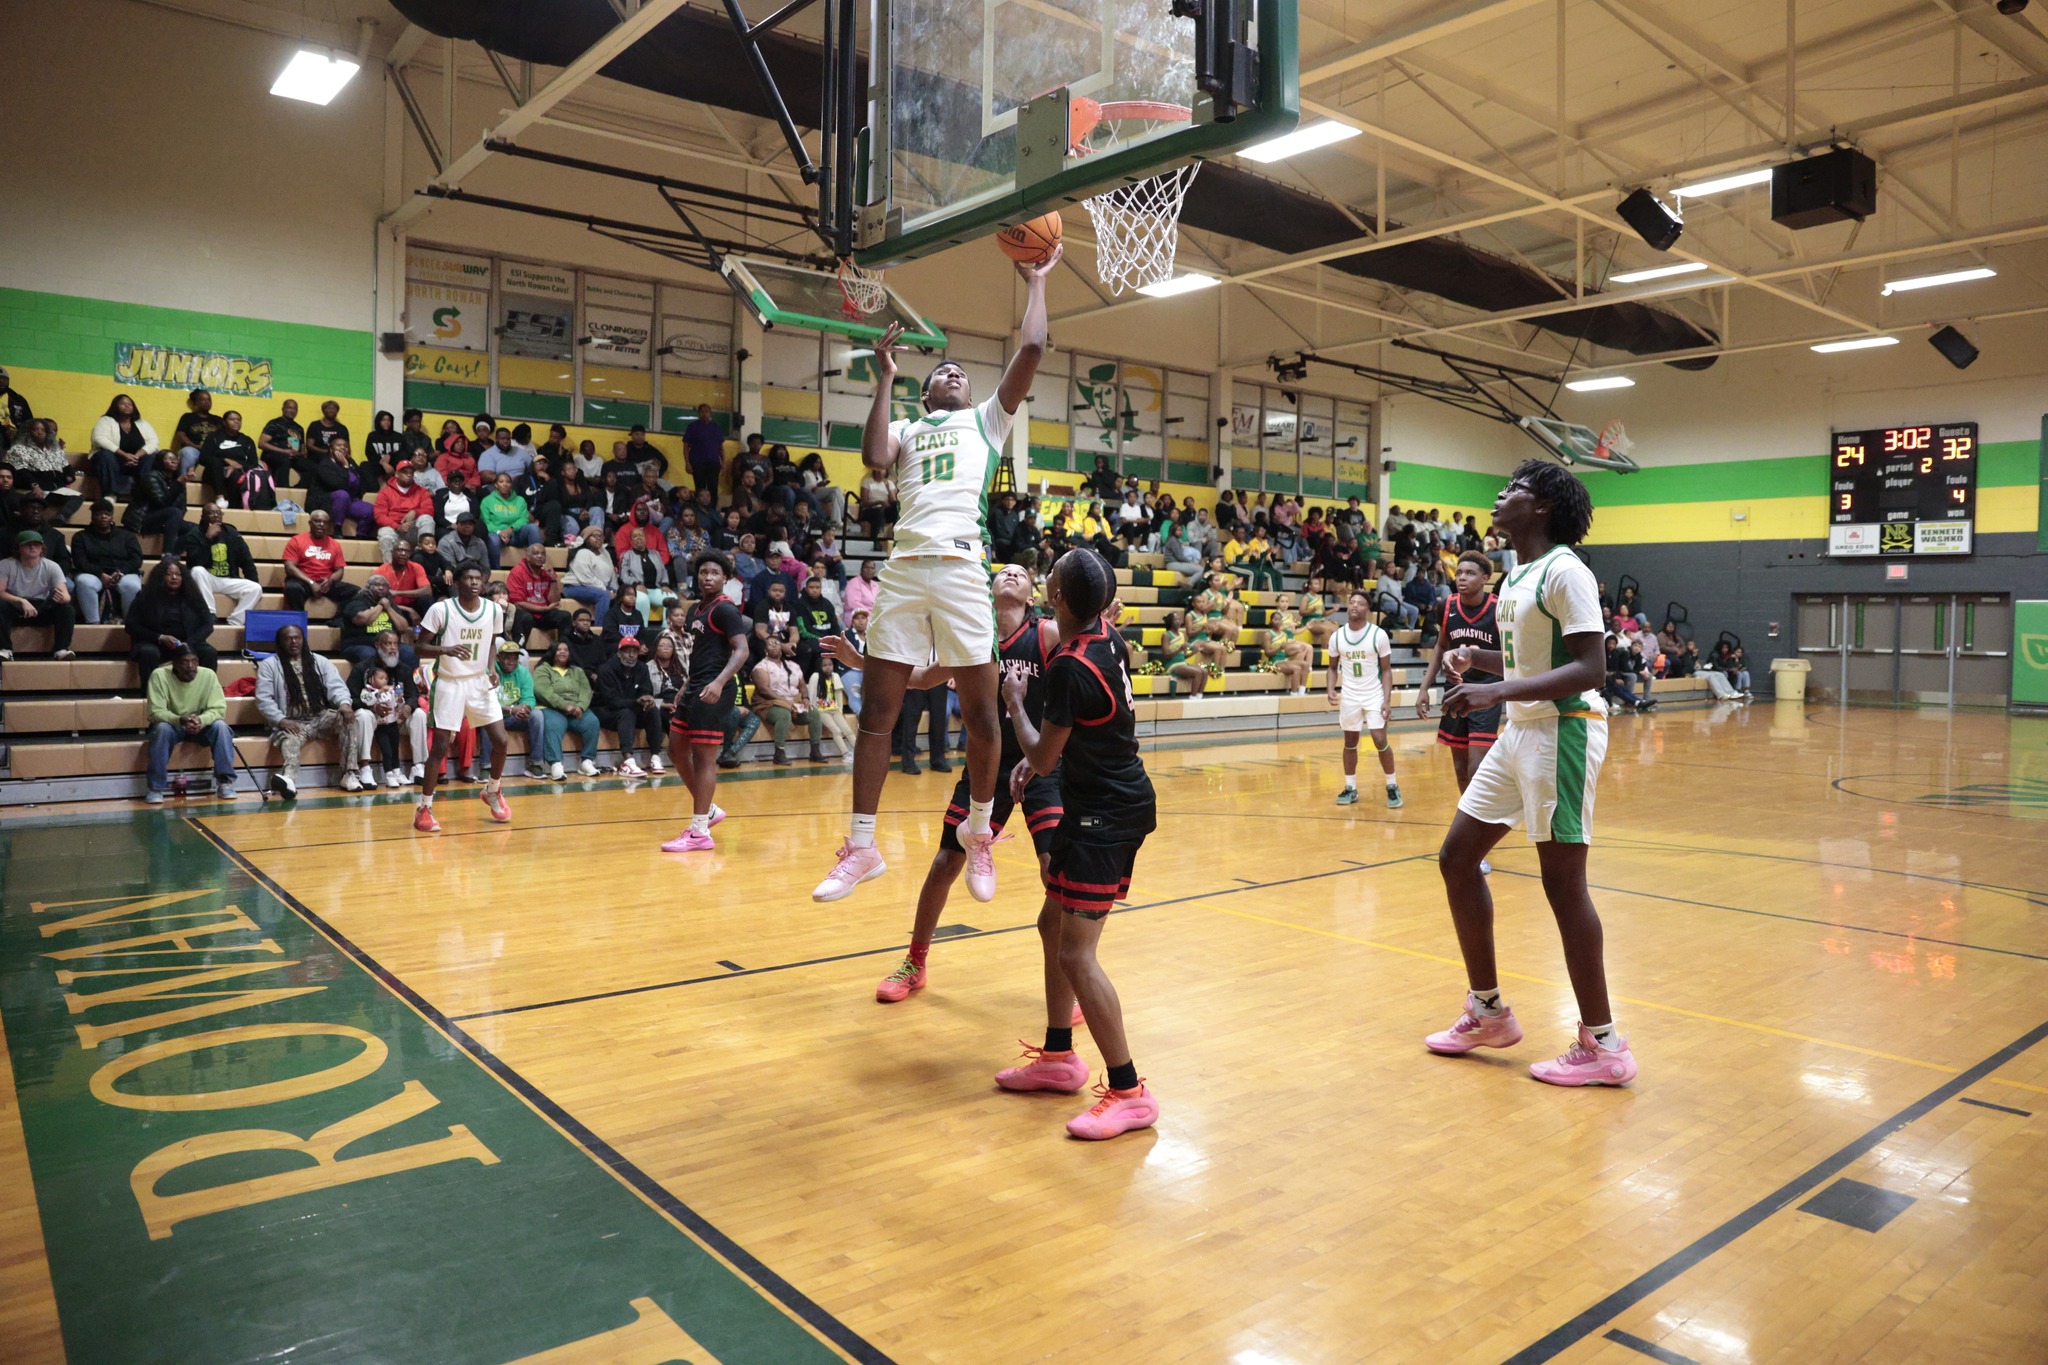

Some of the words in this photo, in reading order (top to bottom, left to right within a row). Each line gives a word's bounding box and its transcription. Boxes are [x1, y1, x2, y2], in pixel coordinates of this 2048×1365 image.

[443, 260, 489, 276] SUBWAY
[510, 269, 522, 277] ESI
[523, 271, 553, 282] Supports
[506, 279, 527, 287] North
[528, 281, 551, 291] Rowan
[407, 284, 441, 300] NORTH
[445, 289, 483, 305] ROWAN
[588, 322, 648, 337] CLONINGER
[595, 343, 613, 352] JUST
[615, 346, 640, 355] BETTER
[116, 348, 271, 395] JUNIORS
[406, 353, 426, 370] Go
[434, 355, 480, 378] Cavs!
[1837, 435, 1860, 445] Home
[1884, 427, 1932, 452] 3:02
[1939, 427, 1970, 438] Guests
[915, 430, 959, 452] CAVS
[1837, 446, 1865, 468] 24
[1942, 438, 1972, 461] 32
[922, 451, 956, 485] 10
[1885, 462, 1914, 474] period
[1920, 457, 1933, 474] 2
[1834, 482, 1855, 491] fouls
[1946, 475, 1968, 485] fouls
[1885, 478, 1913, 489] player
[1841, 493, 1852, 510] 3
[1952, 489, 1966, 504] 4
[1835, 514, 1852, 522] won
[1886, 511, 1909, 521] game
[1946, 509, 1965, 518] won
[1883, 523, 1909, 540] NR
[1921, 528, 1964, 536] KENNETH
[1921, 535, 1964, 543] WASHKO
[1497, 600, 1517, 622] CAVS
[460, 628, 483, 640] CAVS
[1449, 627, 1493, 644] THOMASVILLE
[1345, 650, 1366, 660] CAVS
[1353, 662, 1363, 677] 0
[29, 888, 503, 1241] ROWAN
